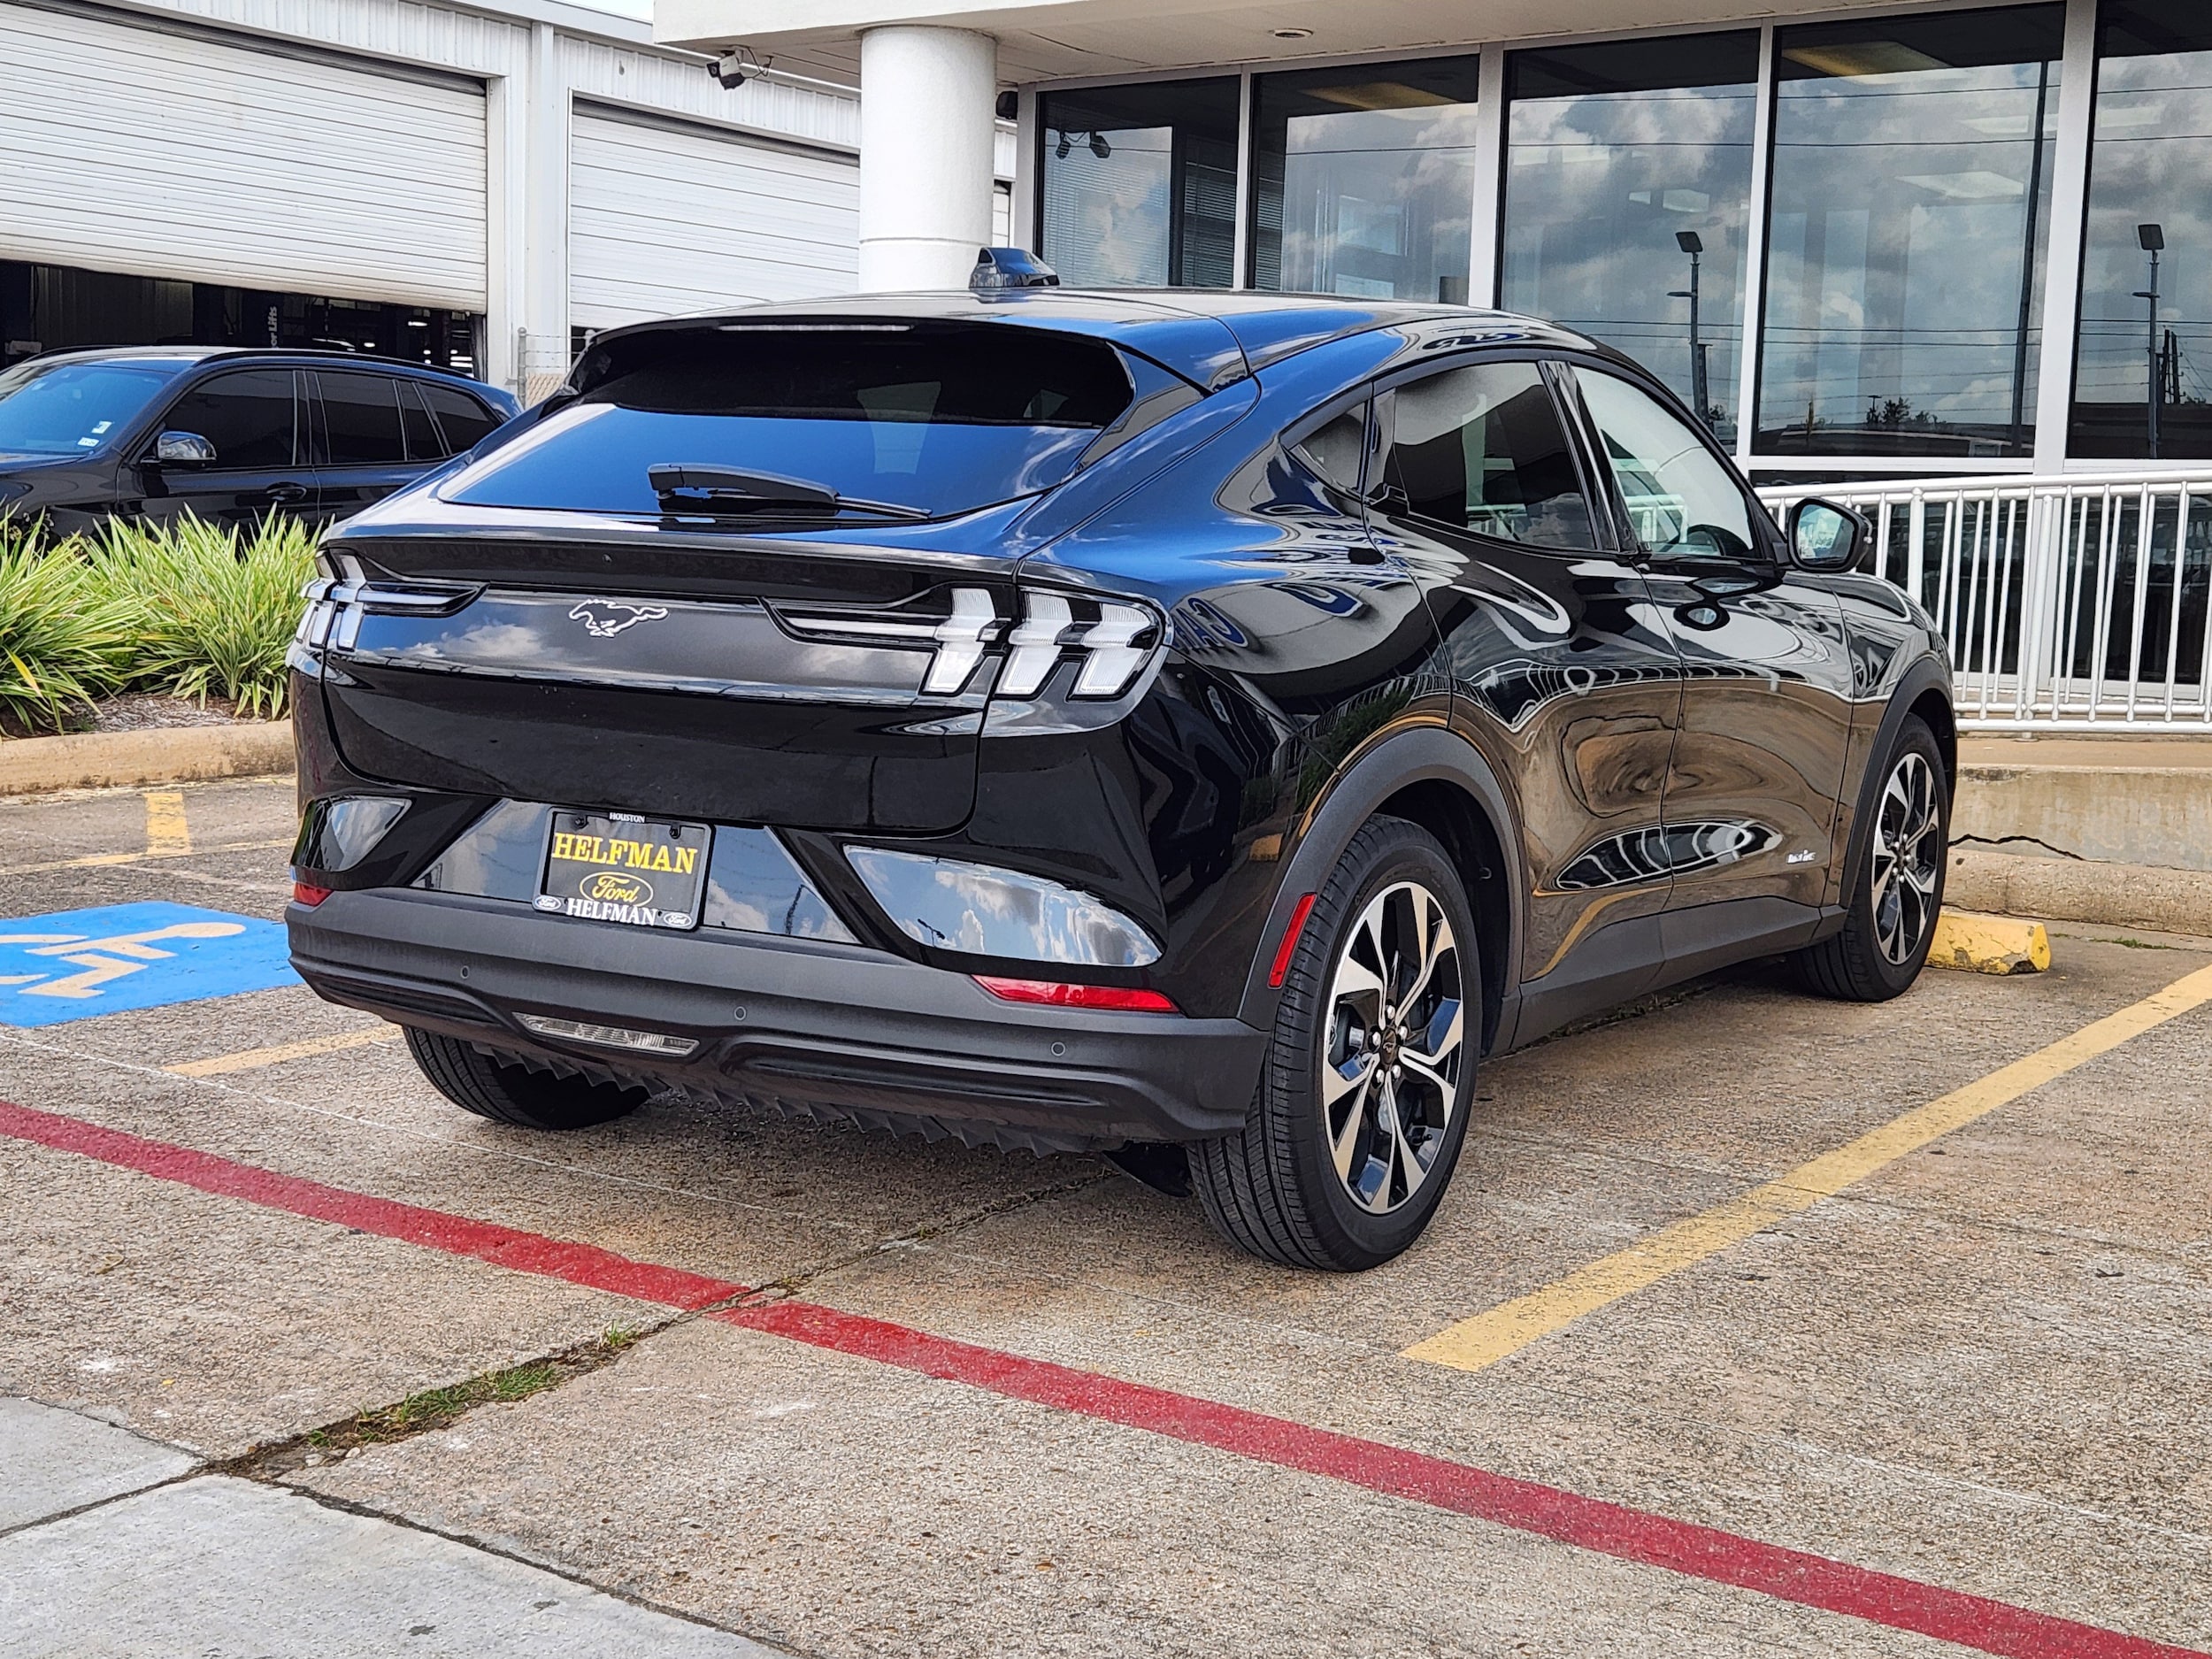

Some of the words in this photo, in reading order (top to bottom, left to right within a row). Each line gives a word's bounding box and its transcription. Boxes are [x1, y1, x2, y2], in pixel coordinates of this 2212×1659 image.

[609, 811, 645, 823] HOUSTON
[551, 832, 698, 874] HELFMAN
[591, 874, 641, 903] Ford
[538, 897, 557, 908] Ford
[566, 898, 658, 926] HELFMAN
[668, 914, 687, 925] Ford
